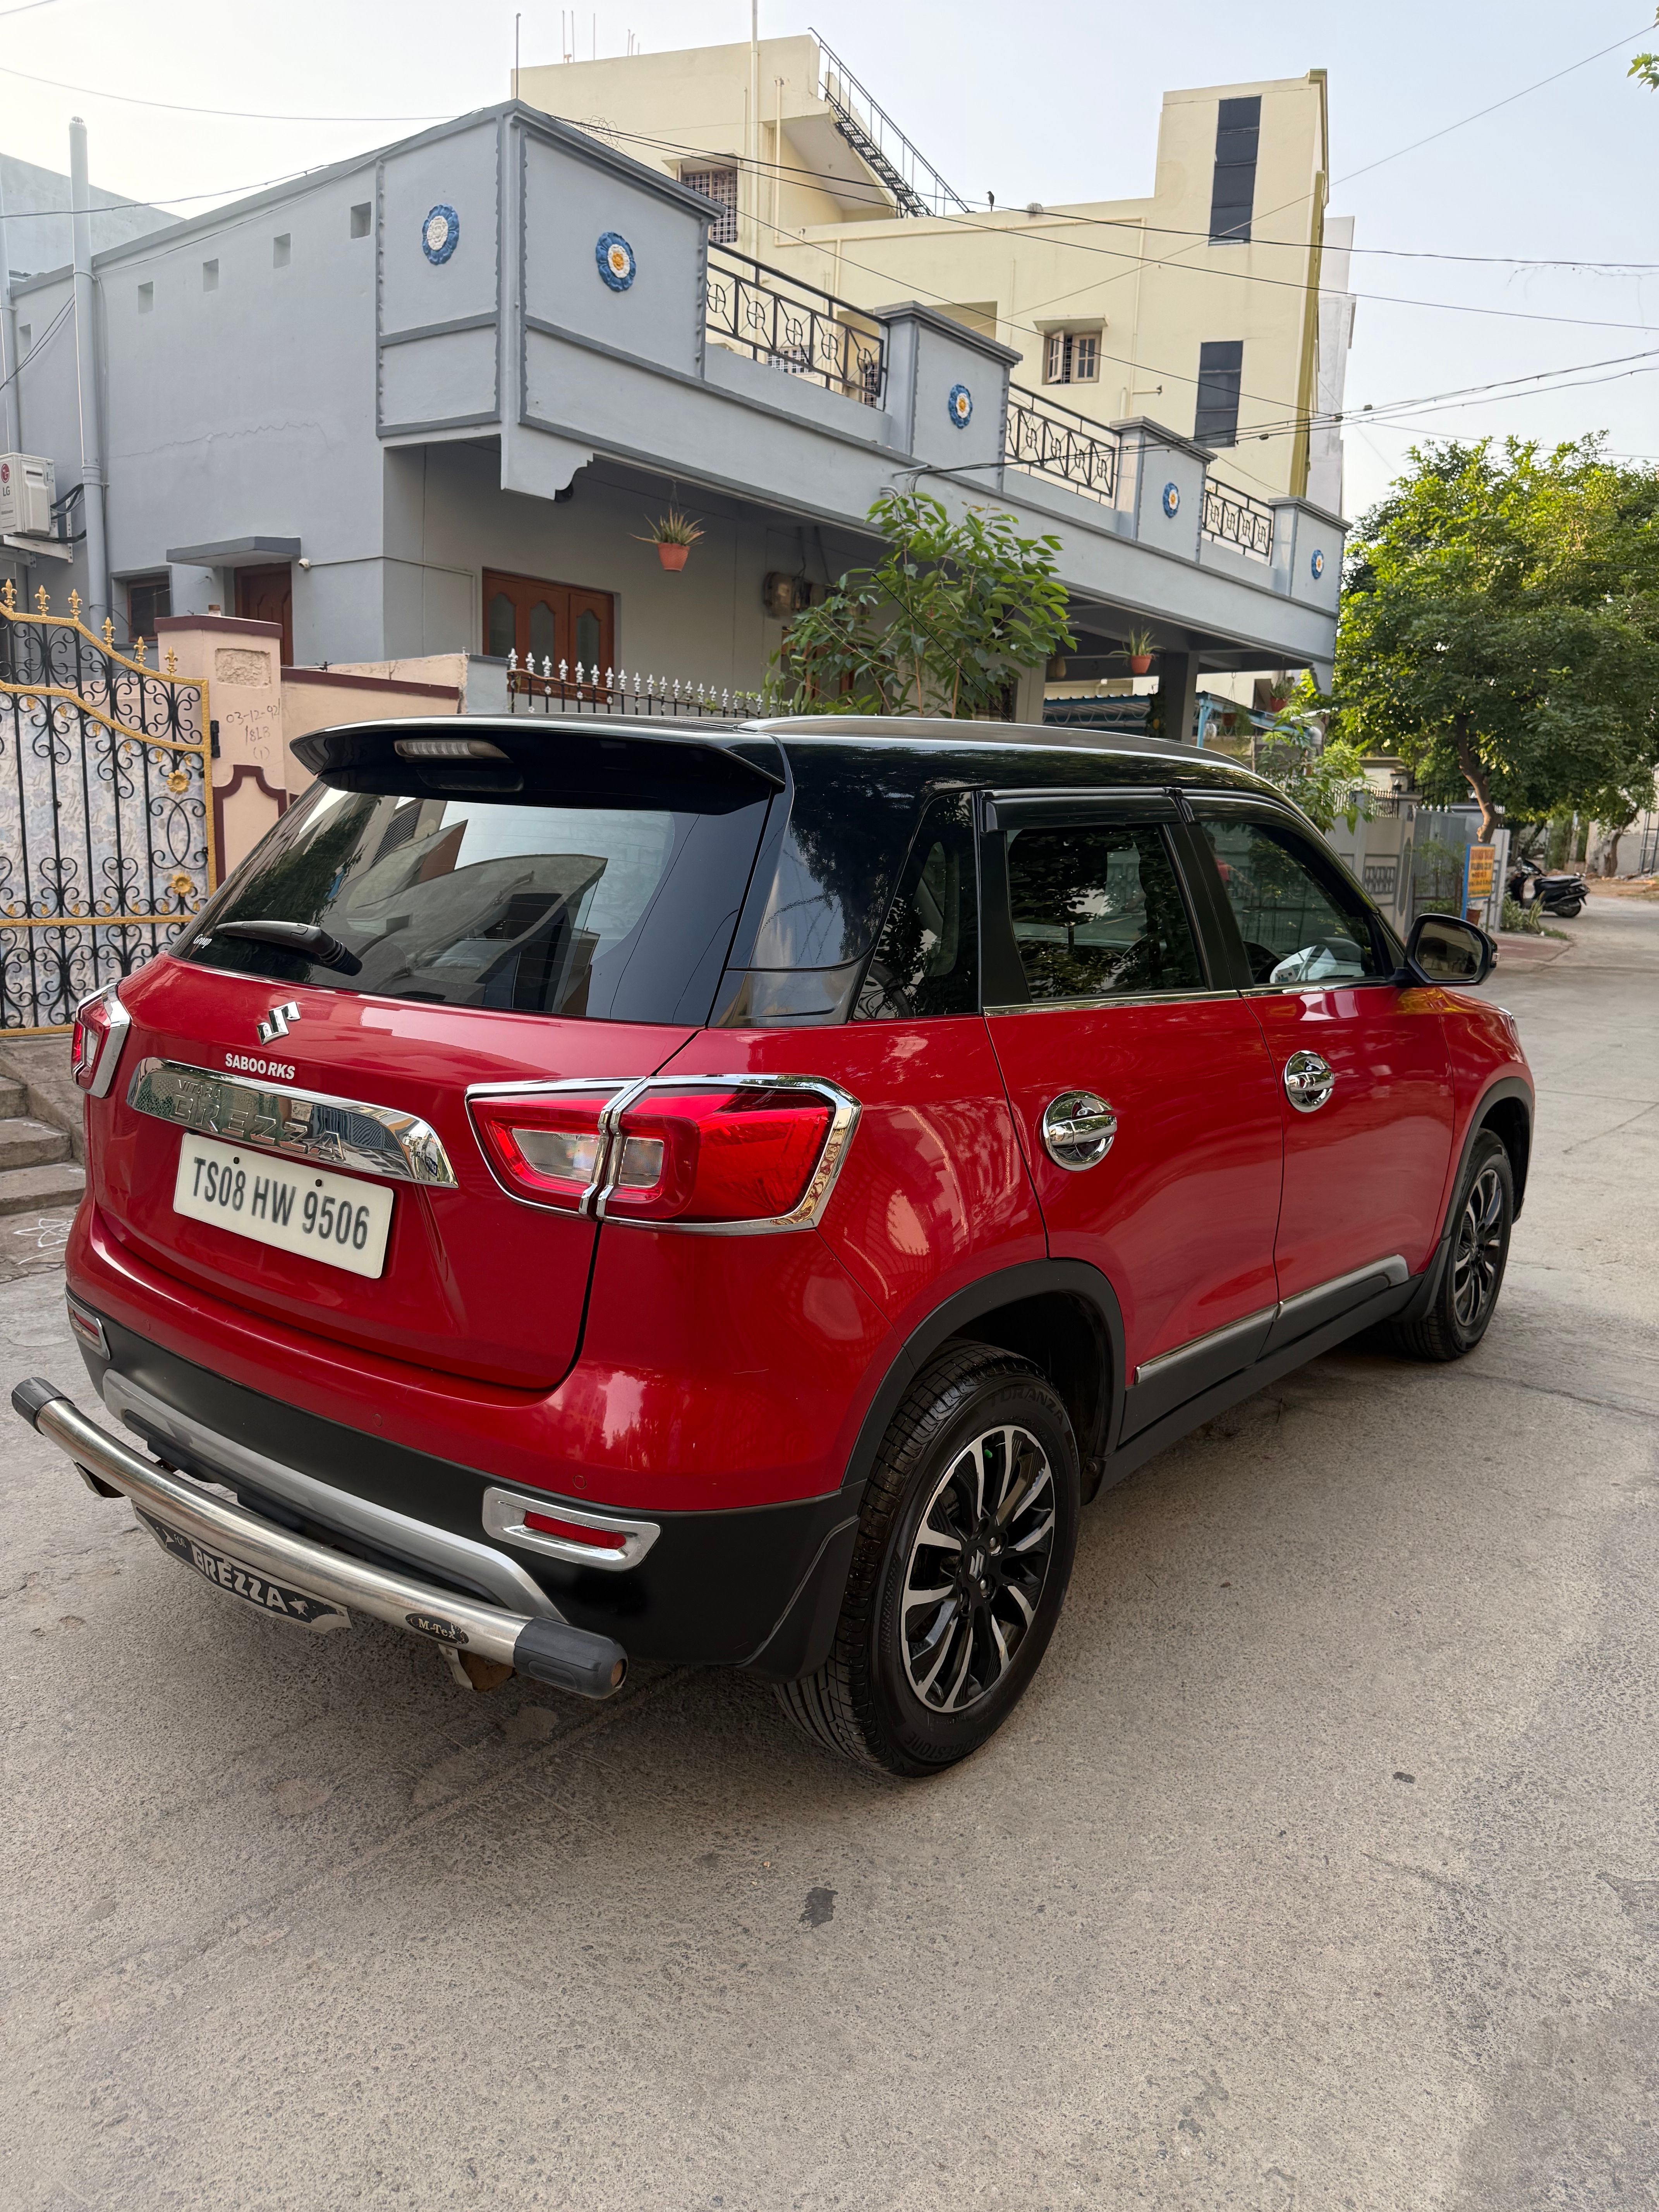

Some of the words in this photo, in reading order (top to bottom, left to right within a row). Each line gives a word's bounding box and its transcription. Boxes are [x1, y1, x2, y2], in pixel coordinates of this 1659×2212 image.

[2, 486, 10, 496] LG
[193, 934, 213, 949] Group
[177, 1079, 221, 1101] VITARA
[170, 1094, 346, 1162] BREZZA
[193, 1156, 246, 1211] TS08
[251, 1175, 297, 1226] HW
[302, 1191, 370, 1250] 9506
[986, 1387, 1064, 1425] TURANZA
[173, 1534, 187, 1549] FOR
[192, 1544, 289, 1613] BREZZA
